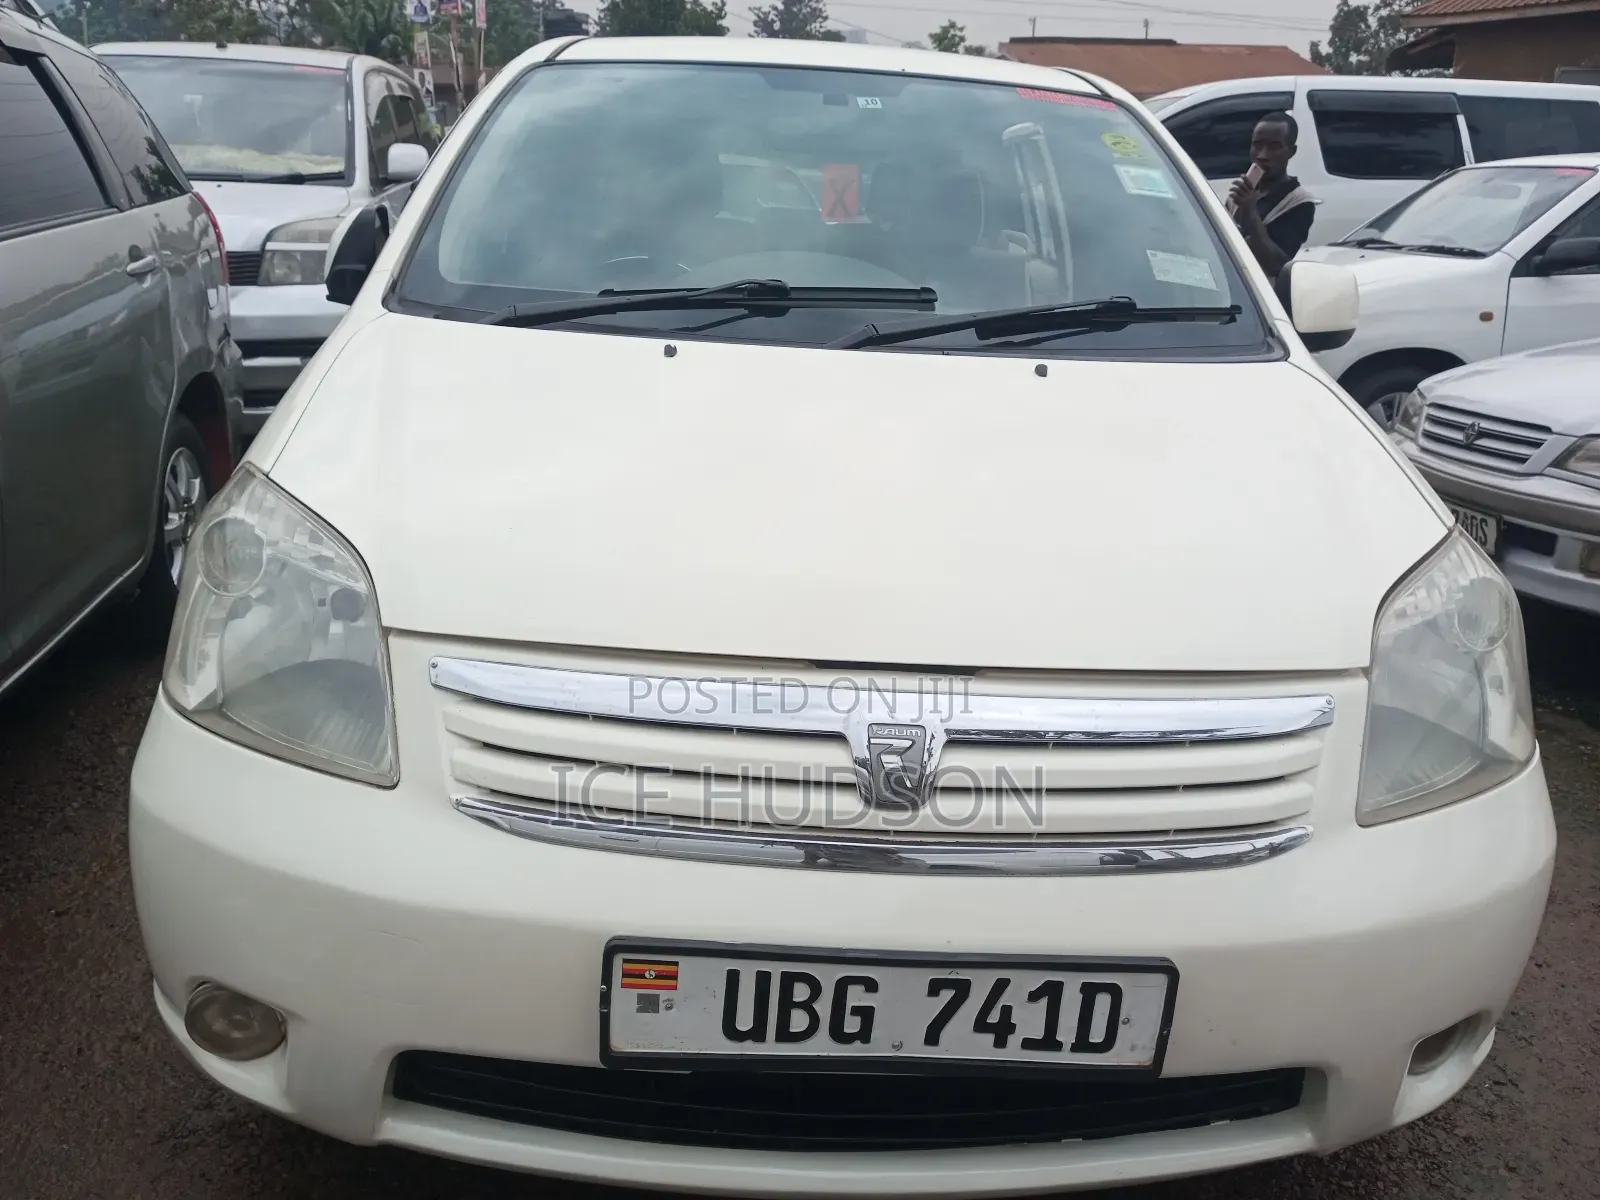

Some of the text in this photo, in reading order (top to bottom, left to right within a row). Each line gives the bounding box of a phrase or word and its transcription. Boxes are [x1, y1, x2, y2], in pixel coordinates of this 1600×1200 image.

[872, 727, 921, 737] RAUM
[722, 968, 1123, 1054] UBG 741D
